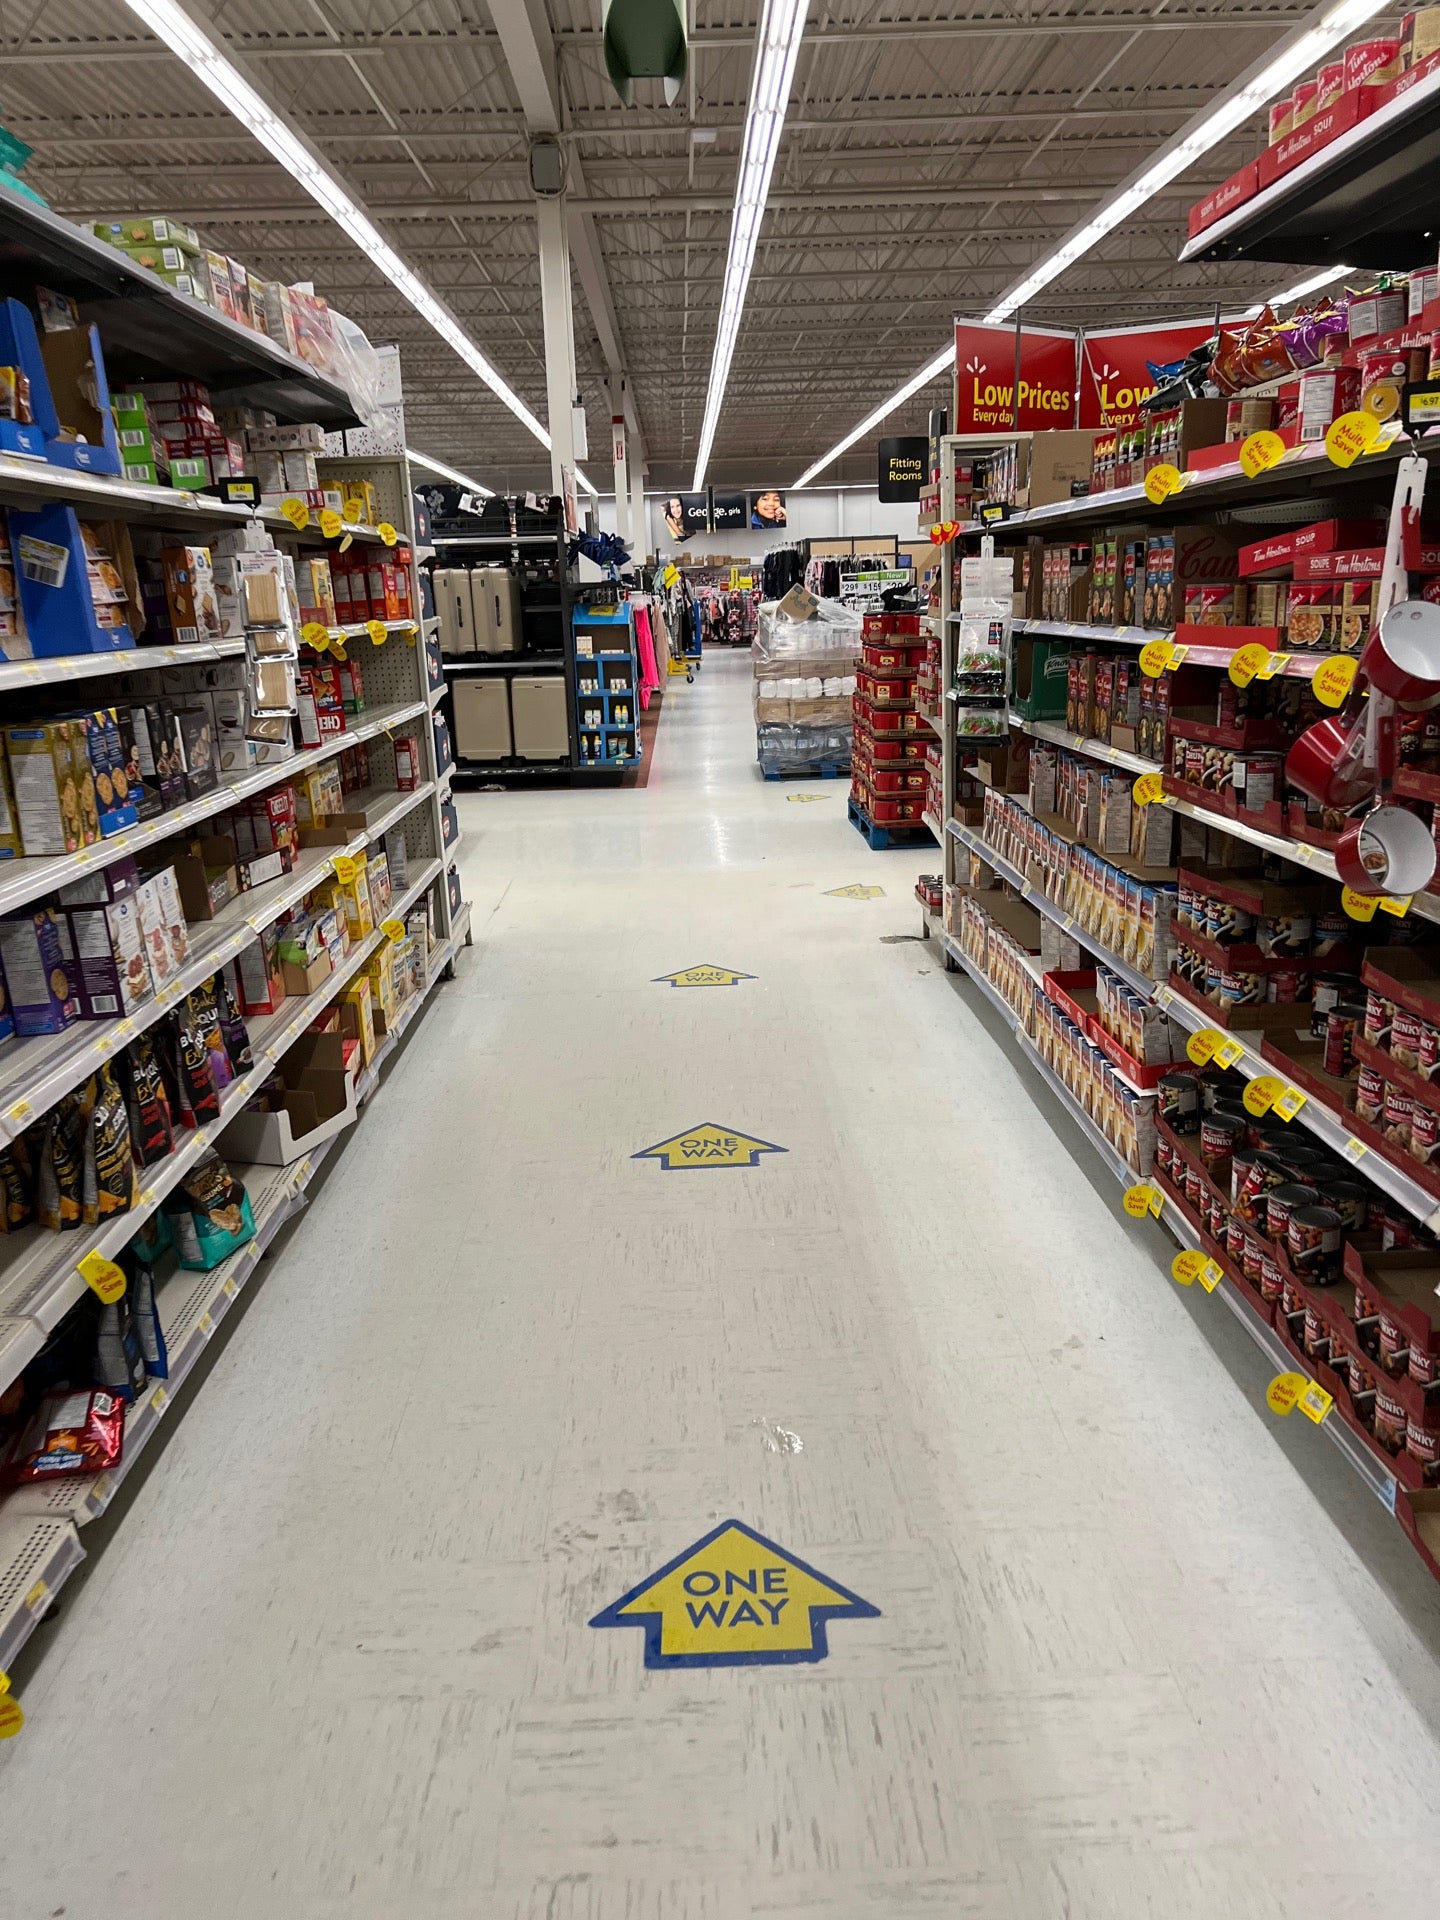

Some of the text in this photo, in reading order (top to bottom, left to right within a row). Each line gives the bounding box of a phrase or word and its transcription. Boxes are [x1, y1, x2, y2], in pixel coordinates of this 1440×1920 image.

[1313, 115, 1333, 136] SOUP
[974, 377, 1070, 411] Low Prices
[973, 408, 1014, 426] Every day
[1100, 413, 1135, 426] Every
[1339, 424, 1366, 447] Multi
[1253, 439, 1271, 464] Multi
[1331, 435, 1354, 456] Save
[890, 458, 921, 470] Fitting
[1246, 448, 1261, 469] Save
[889, 471, 922, 481] Rooms
[1152, 473, 1171, 489] Multi
[1149, 481, 1165, 497] Save
[688, 507, 741, 519] Geoge. girls
[1295, 532, 1316, 547] SOUP
[1253, 545, 1291, 562] Tim Hortons
[1310, 554, 1381, 574] SOUPE Tim Hortons
[1144, 658, 1161, 669] Save
[1147, 650, 1167, 662] Multi
[1238, 653, 1257, 671] Multi
[1233, 663, 1251, 679] Save
[1323, 669, 1349, 689] Multi
[1319, 680, 1343, 698] Save
[1347, 895, 1371, 911] Save
[1190, 1043, 1207, 1059] Save
[1195, 1036, 1214, 1054] Multi
[1251, 1083, 1273, 1102] Multi
[1247, 1092, 1266, 1110] Save
[1387, 1096, 1414, 1113] CHUN
[680, 1138, 738, 1149] ONE
[1202, 1133, 1232, 1146] CHUNKY
[681, 1147, 738, 1158] WAY
[1128, 1194, 1147, 1204] Multi
[1128, 1202, 1144, 1211] Save
[1175, 1265, 1192, 1278] Save
[1178, 1258, 1198, 1272] Multi
[1270, 1391, 1290, 1407] Save
[1275, 1383, 1296, 1400] Multi
[683, 1568, 788, 1596] ONE
[685, 1598, 789, 1629] WAY
